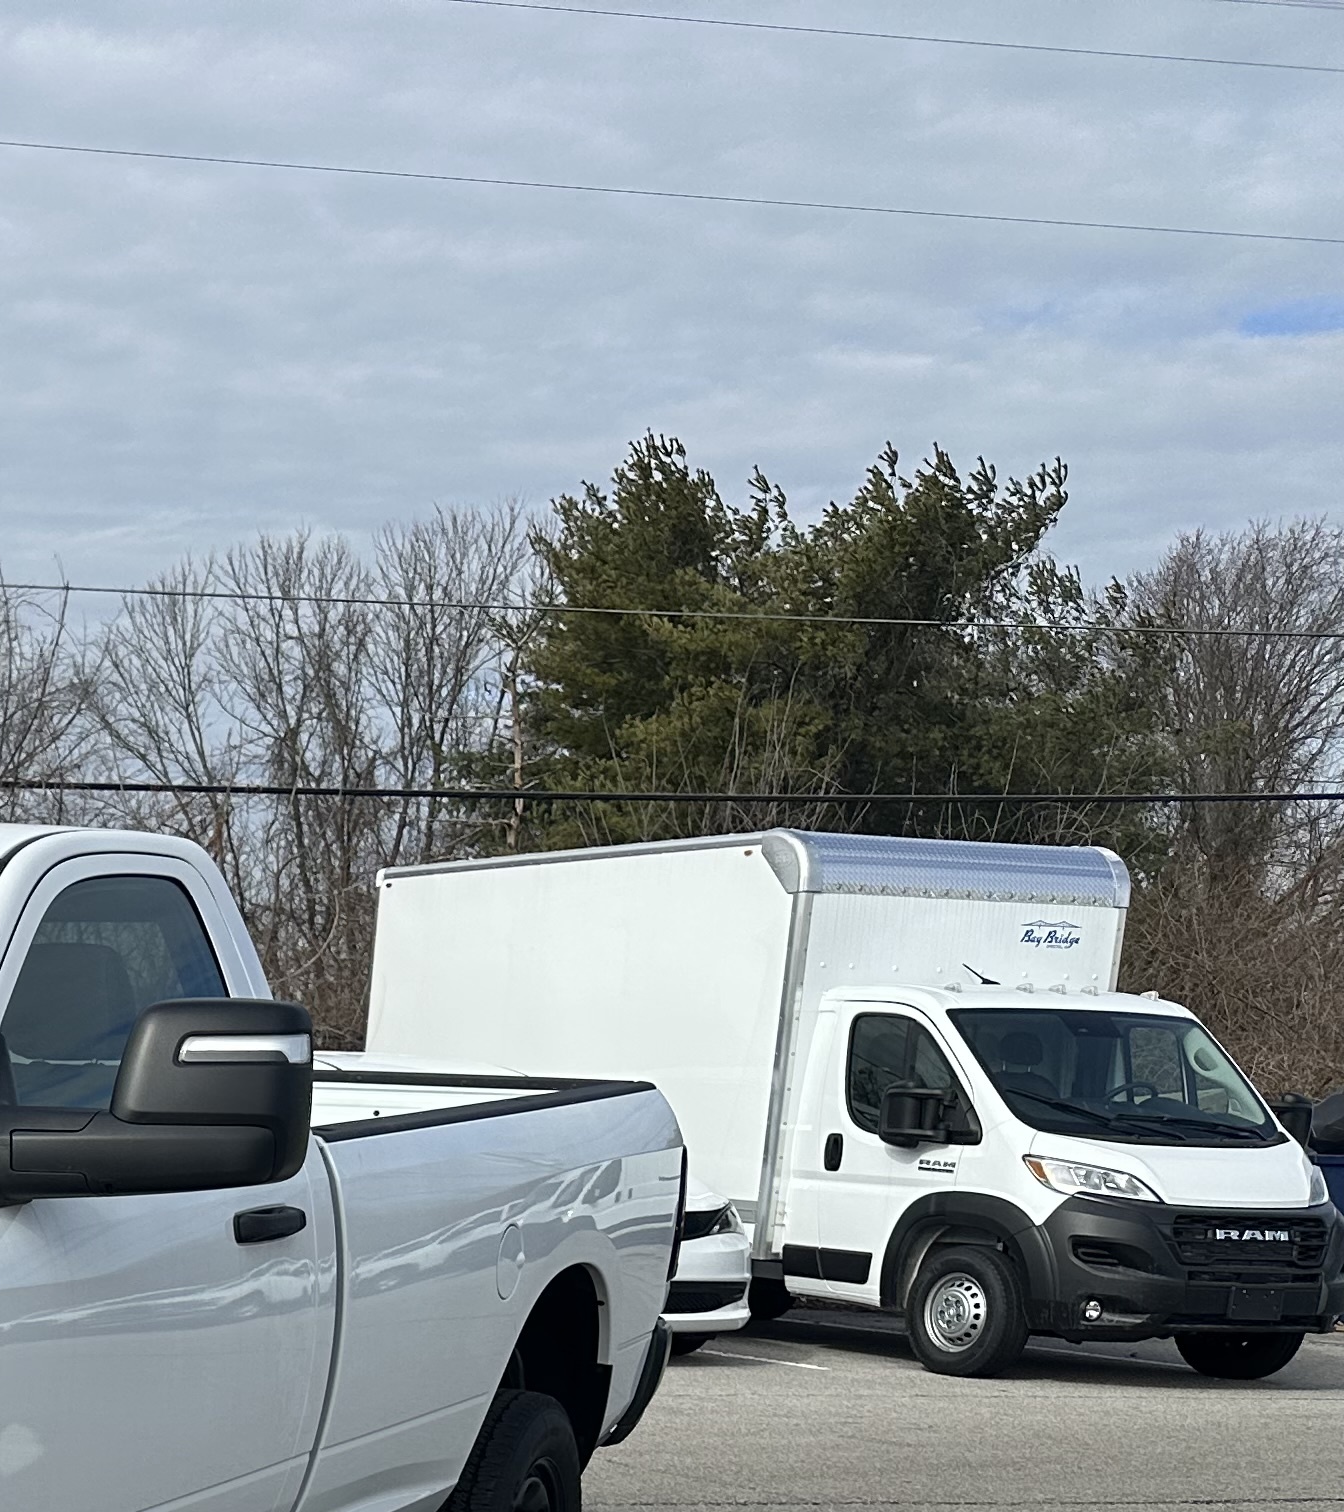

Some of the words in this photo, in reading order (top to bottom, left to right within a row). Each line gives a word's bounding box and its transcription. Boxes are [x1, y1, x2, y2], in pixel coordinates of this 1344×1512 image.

[1020, 929, 1043, 948] Bay
[1043, 930, 1080, 949] Bridge
[919, 1159, 956, 1168] RAM
[1216, 1228, 1289, 1241] RAM
